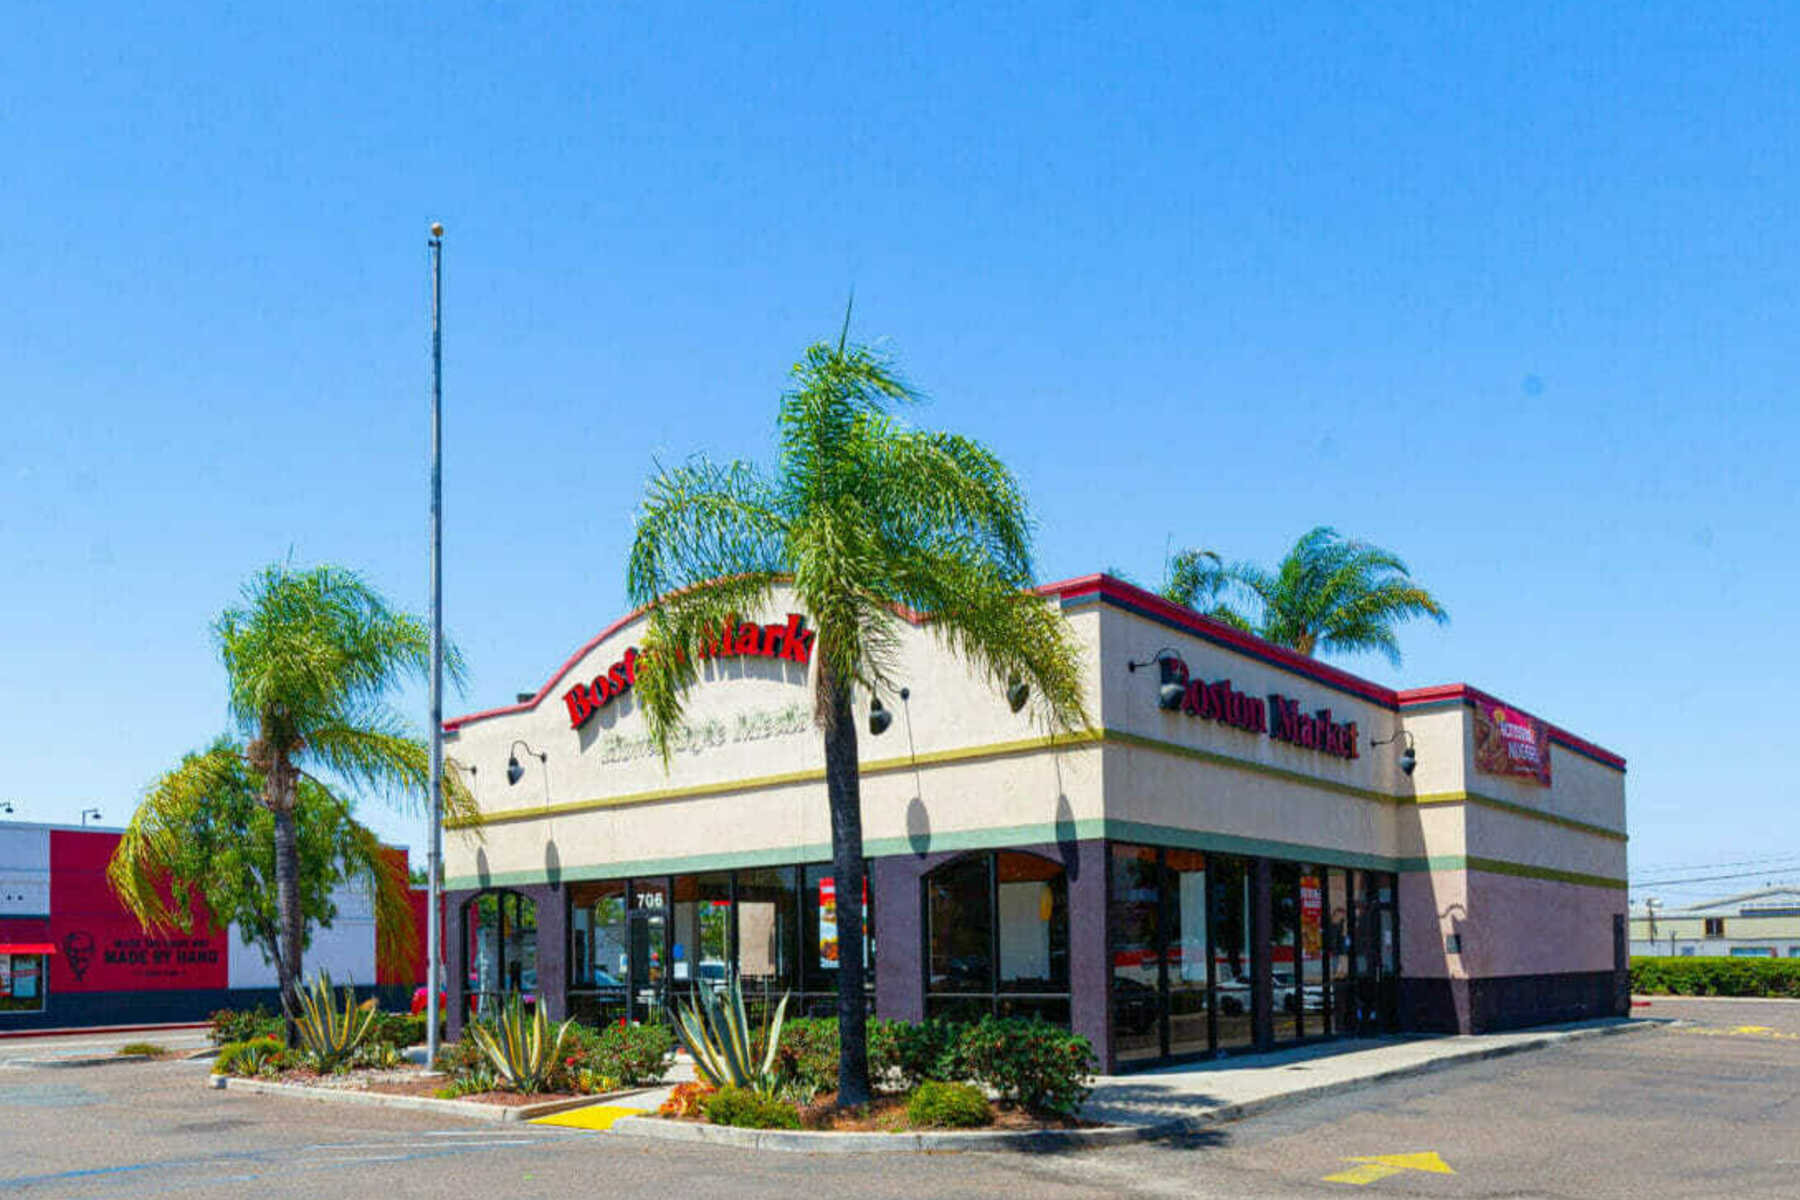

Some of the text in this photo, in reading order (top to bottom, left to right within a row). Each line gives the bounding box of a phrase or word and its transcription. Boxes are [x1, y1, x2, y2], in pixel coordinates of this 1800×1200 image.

[563, 613, 814, 730] Bost Mark
[1268, 693, 1360, 760] Market
